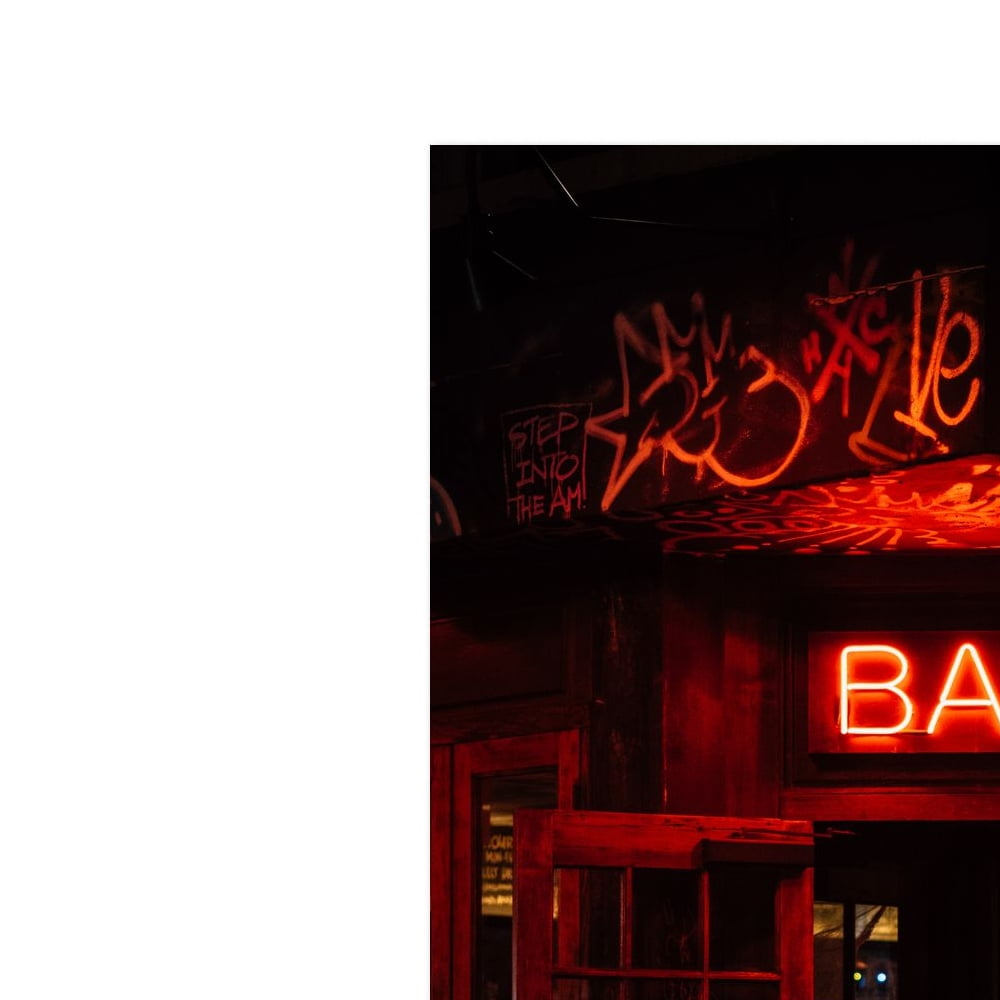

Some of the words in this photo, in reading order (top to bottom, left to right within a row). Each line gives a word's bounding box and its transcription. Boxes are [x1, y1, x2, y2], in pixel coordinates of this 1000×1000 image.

[508, 411, 580, 450] STEP
[515, 450, 580, 488] INTO
[507, 493, 546, 524] THE
